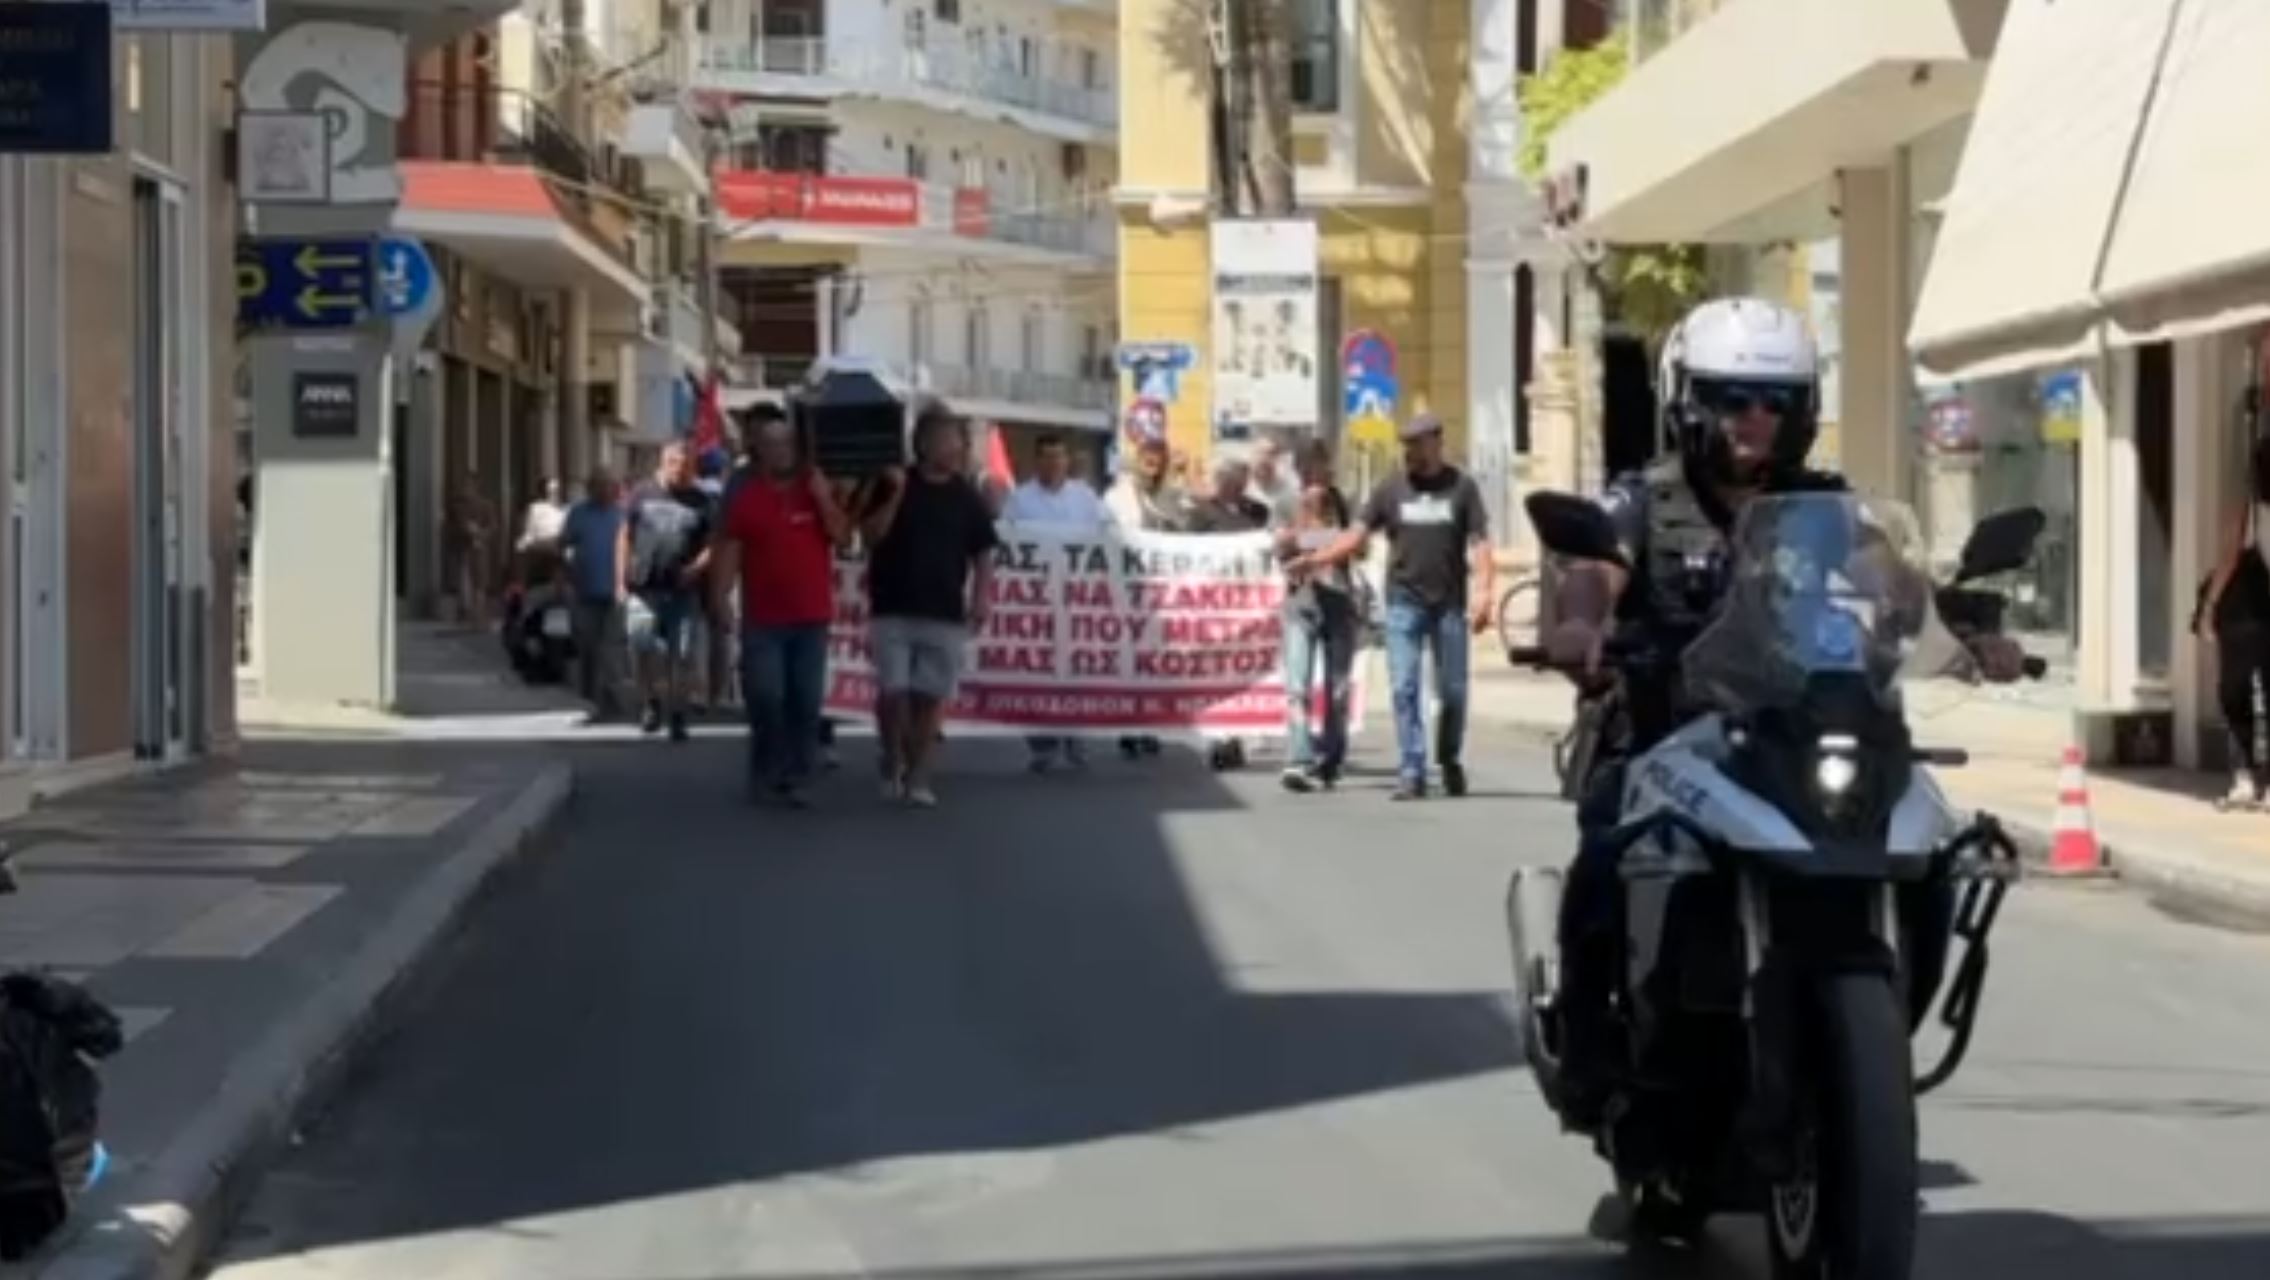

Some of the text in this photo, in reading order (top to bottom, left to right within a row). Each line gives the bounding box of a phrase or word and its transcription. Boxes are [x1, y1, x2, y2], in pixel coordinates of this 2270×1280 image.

[1064, 543, 1110, 573] ΤΑ
[1063, 578, 1113, 606] ΝΑ
[1071, 613, 1147, 642] ΠΟΥ
[977, 645, 1055, 674] ΜΑΣ
[1071, 650, 1119, 675] ΩΣ
[1133, 646, 1277, 677] ΚΟΣΤΟΣ
